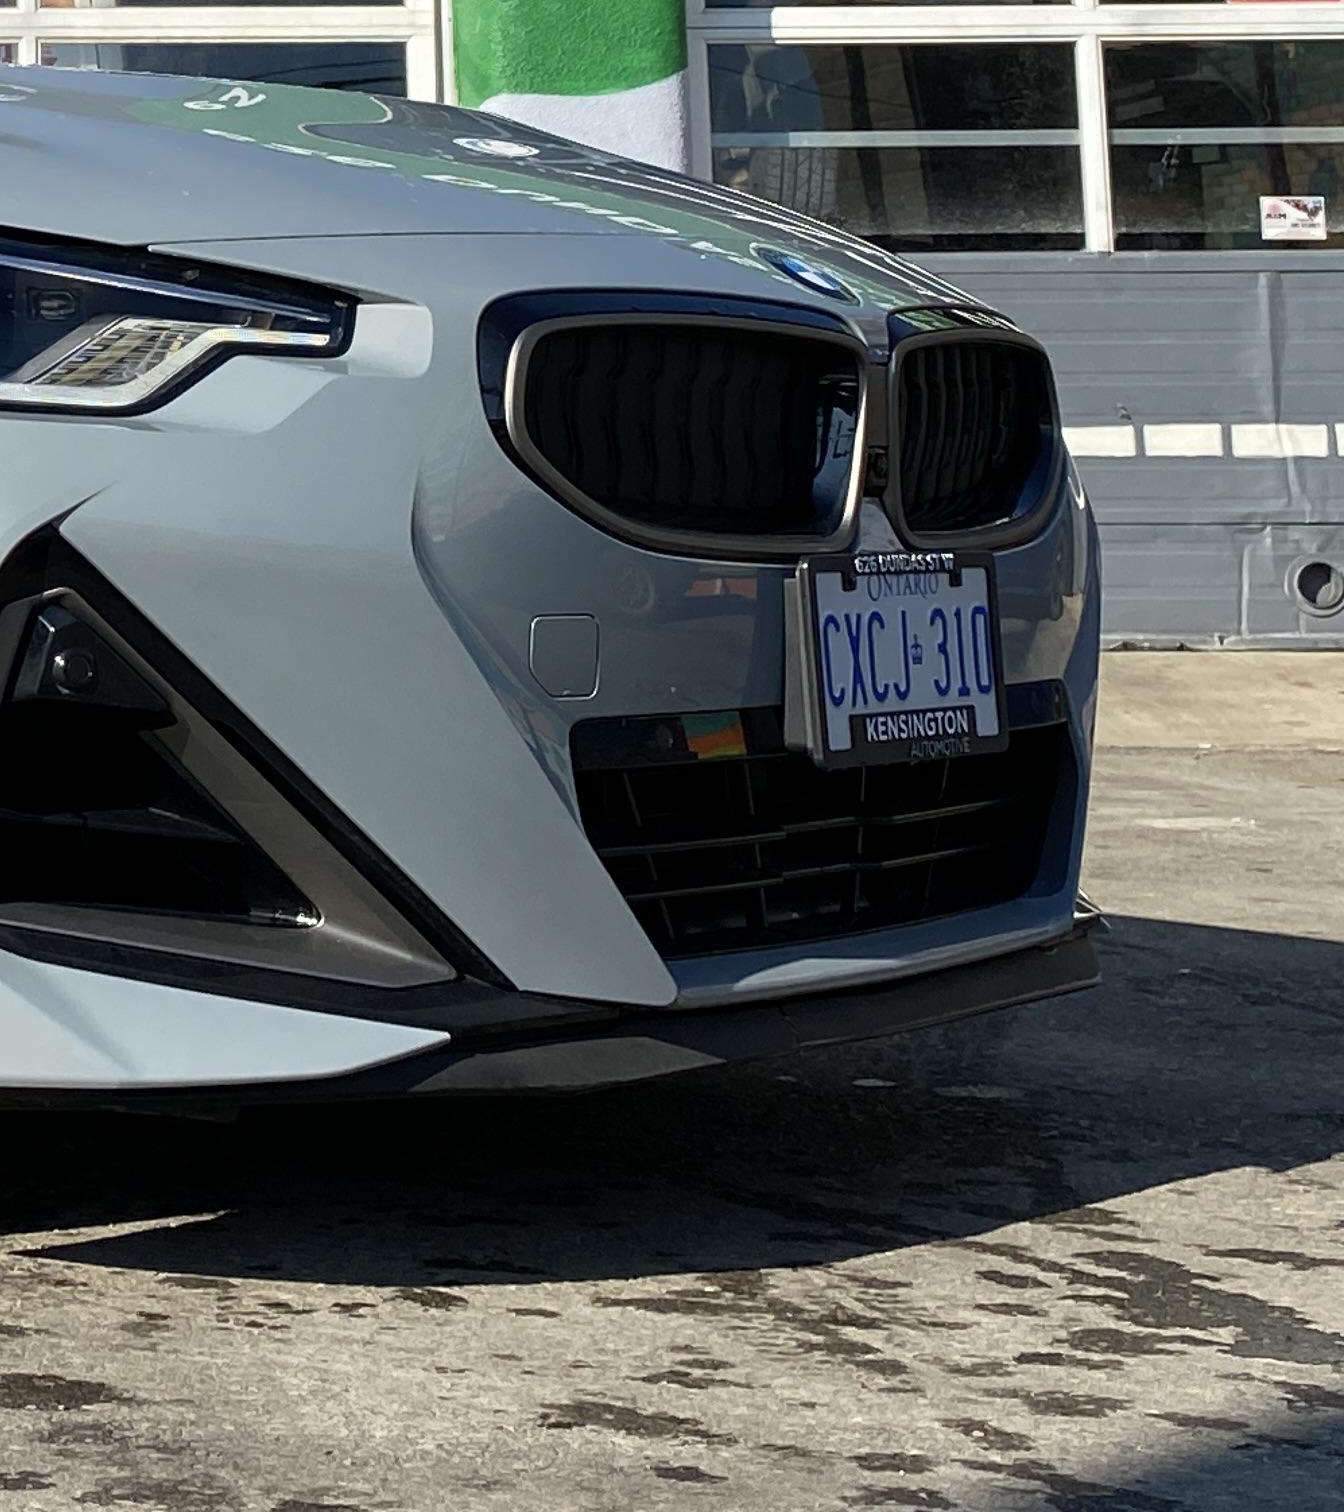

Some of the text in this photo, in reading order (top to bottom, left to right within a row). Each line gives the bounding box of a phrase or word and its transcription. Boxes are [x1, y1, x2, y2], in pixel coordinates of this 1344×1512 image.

[854, 555, 878, 574] 626
[878, 553, 926, 573] DUNDAS
[867, 574, 939, 602] ONTARIO
[865, 709, 970, 742] KENSINGTON
[911, 736, 971, 758] AUTOMOTIVE
